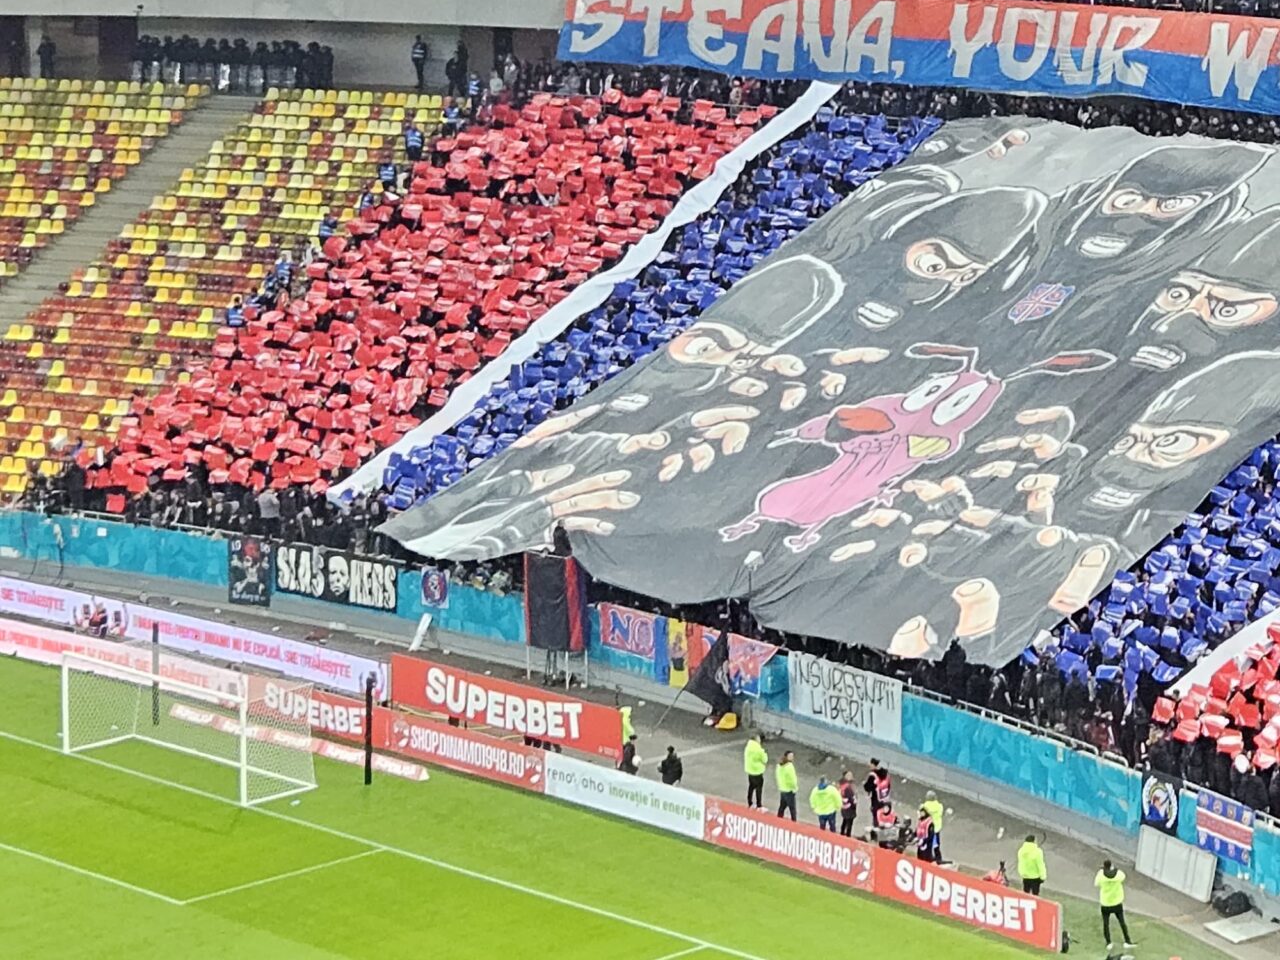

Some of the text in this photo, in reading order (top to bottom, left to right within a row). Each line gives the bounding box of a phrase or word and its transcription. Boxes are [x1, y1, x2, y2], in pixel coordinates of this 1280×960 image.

[947, 4, 1161, 86] YOUR
[425, 668, 582, 739] SUPERBET
[895, 859, 1037, 932] SUPERBET
